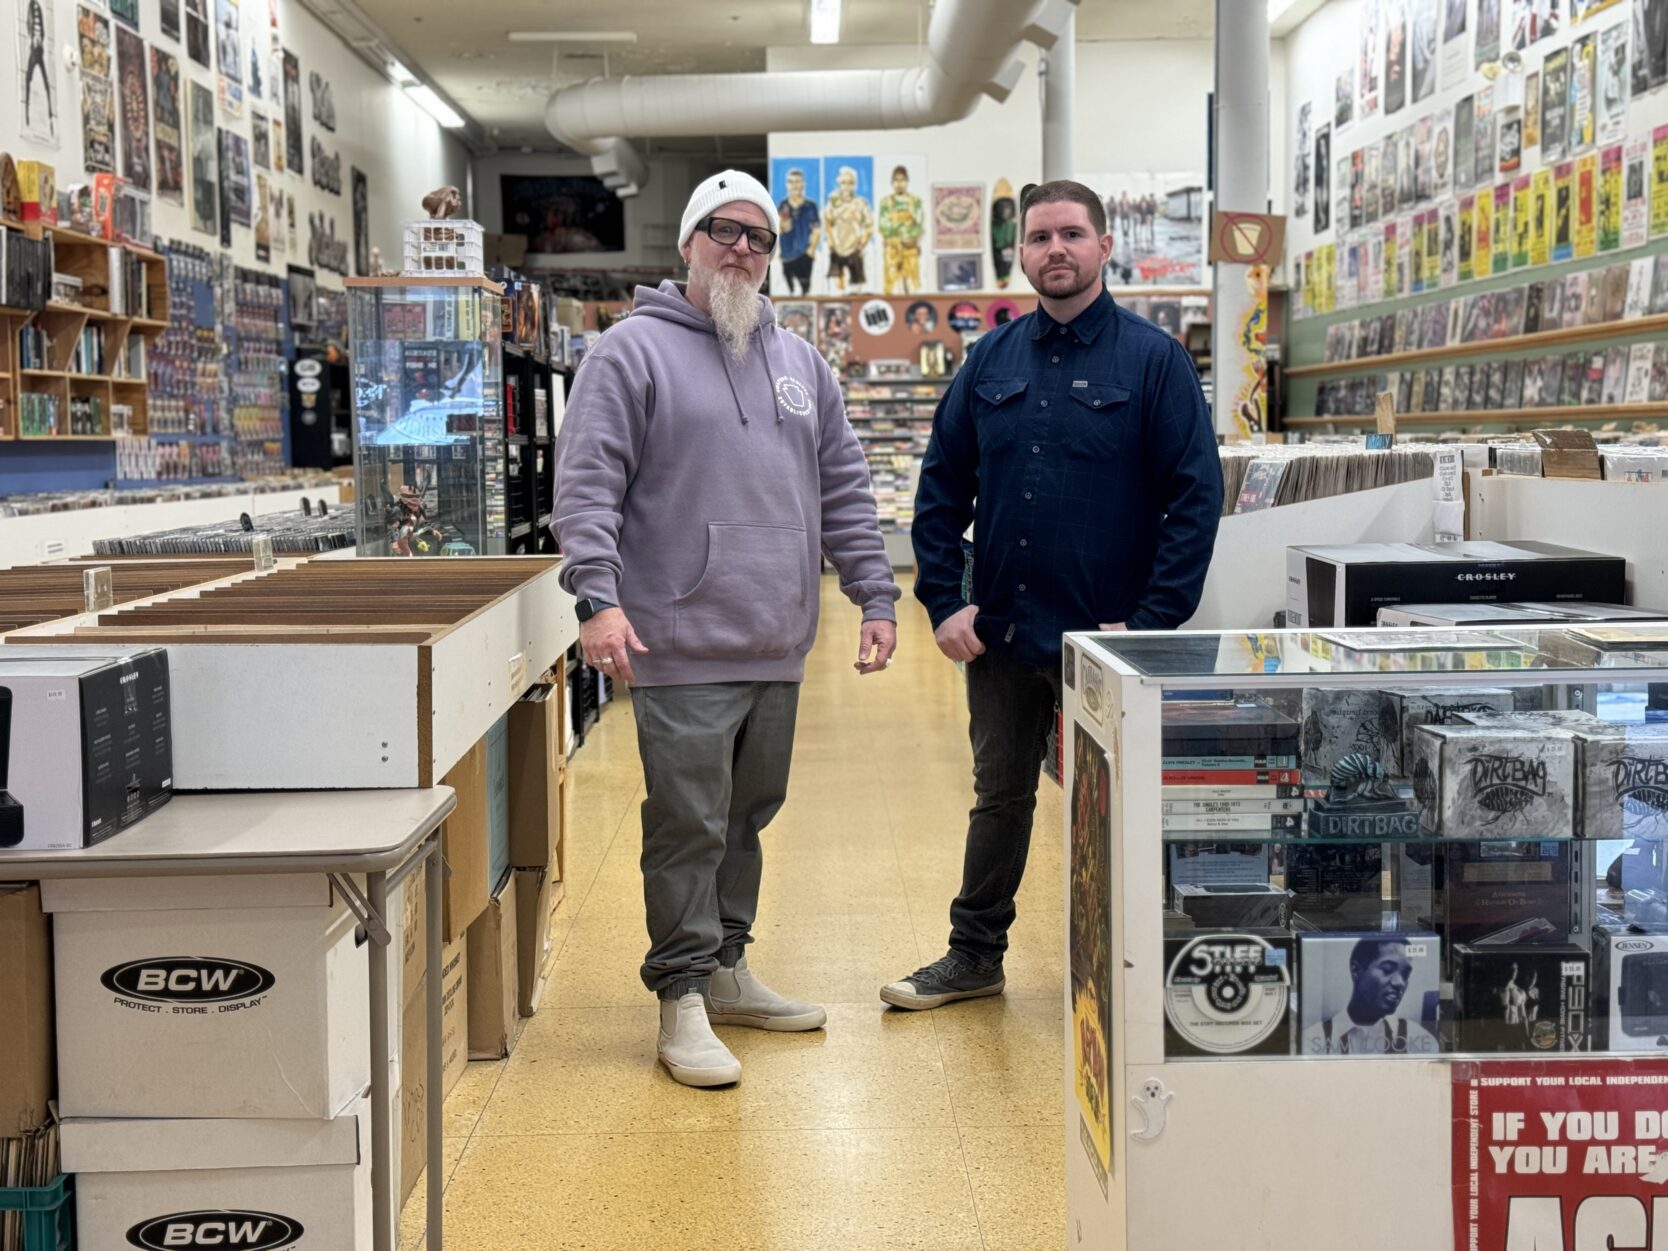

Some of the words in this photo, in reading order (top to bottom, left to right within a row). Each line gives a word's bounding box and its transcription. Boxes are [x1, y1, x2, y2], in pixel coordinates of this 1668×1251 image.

[1456, 572, 1516, 581] CROSLEY
[113, 997, 162, 1014] PROTECT
[172, 1006, 208, 1014] STORE
[1311, 1036, 1349, 1053] SAM
[1361, 1035, 1431, 1052] COOKE
[1480, 1077, 1531, 1086] SUPPORT
[1536, 1076, 1565, 1086] YOUR
[1569, 1076, 1602, 1086] LOCAL
[1470, 1090, 1478, 1115] STORE
[1492, 1112, 1525, 1141] IF
[1540, 1111, 1619, 1141] YOU
[1470, 1118, 1478, 1170] INDEPENDENT
[1488, 1146, 1568, 1174] YOU
[1583, 1145, 1656, 1174] ARE
[1470, 1171, 1478, 1197] LOCAL
[1470, 1199, 1478, 1220] YOUR
